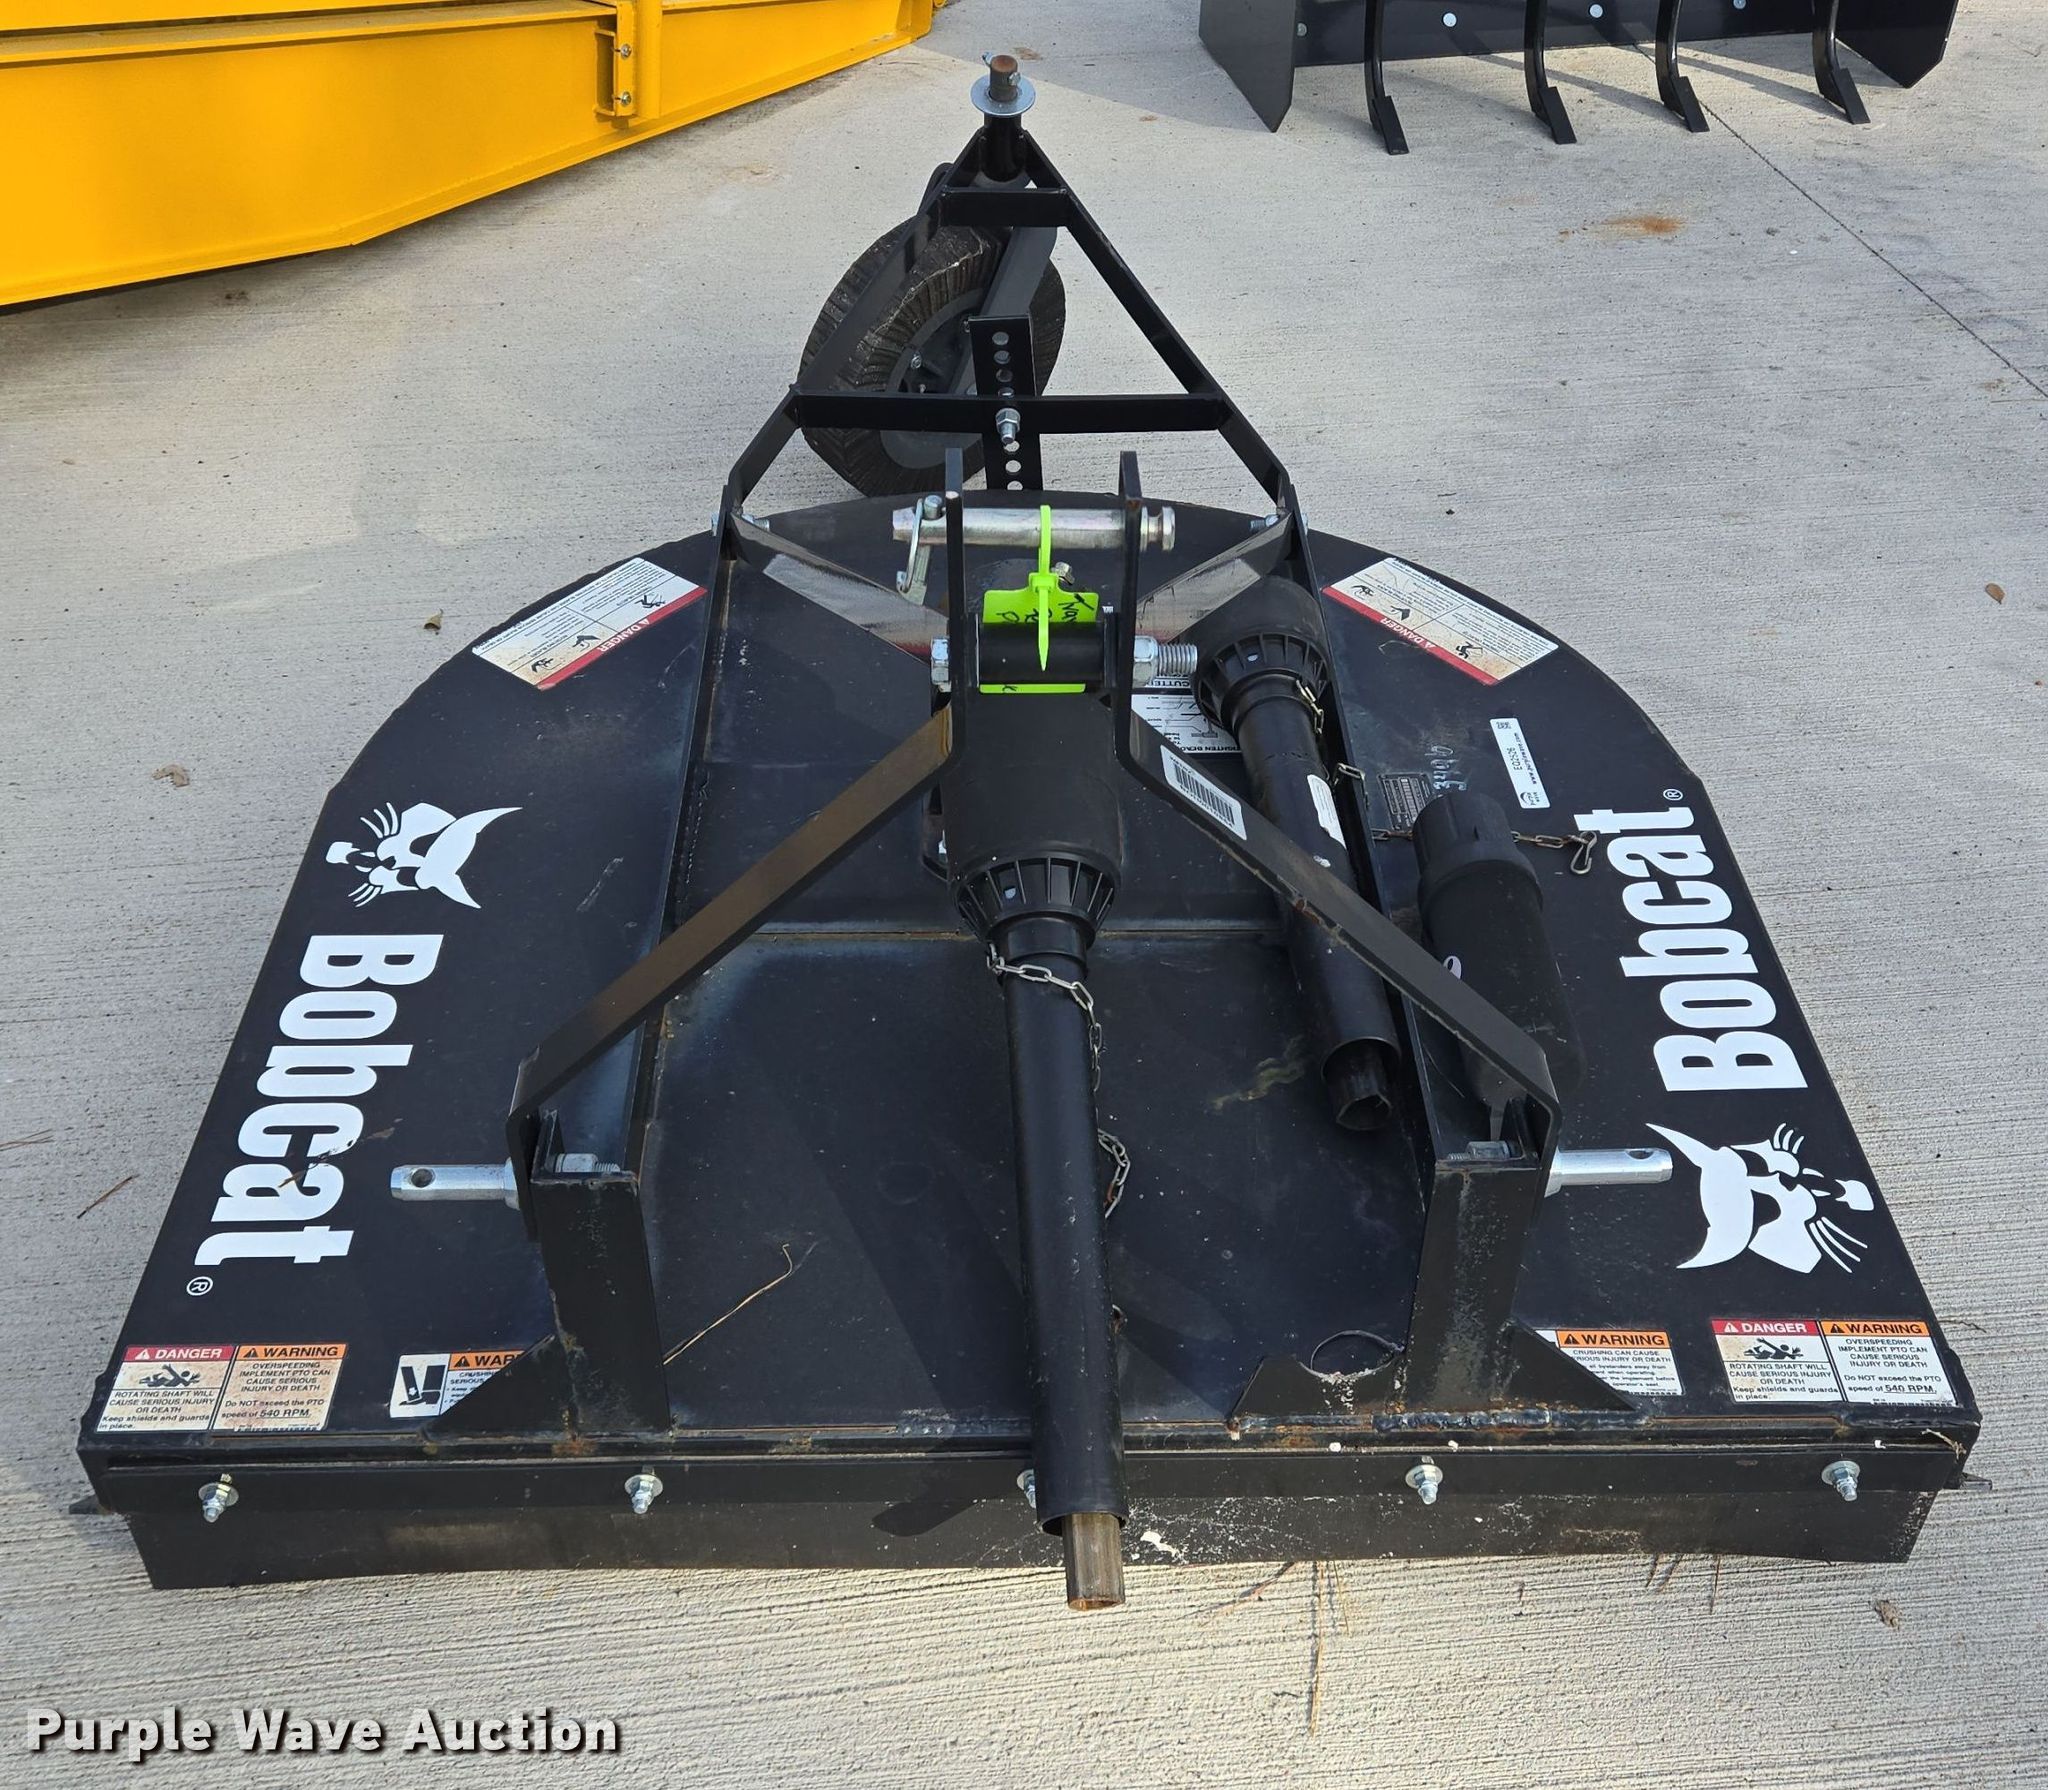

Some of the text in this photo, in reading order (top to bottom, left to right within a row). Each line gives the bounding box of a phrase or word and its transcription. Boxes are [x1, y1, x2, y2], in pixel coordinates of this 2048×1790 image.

[1380, 617, 1425, 644] DANGER
[597, 624, 642, 652] DANGER
[1574, 806, 1808, 1091] Bobcat
[194, 934, 444, 1265] Bobcat
[1741, 1323, 1807, 1333] DANGER
[1845, 1323, 1922, 1334] WARNING
[1581, 1334, 1665, 1346] WARNING
[155, 1348, 223, 1359] DANGER
[263, 1346, 339, 1358] WARNING
[1733, 1386, 1755, 1394] Keep
[1808, 1386, 1839, 1394] guards
[1848, 1385, 1874, 1393] speed
[1885, 1384, 1904, 1393] 540
[225, 1400, 237, 1408] Do
[221, 1411, 247, 1419] speed
